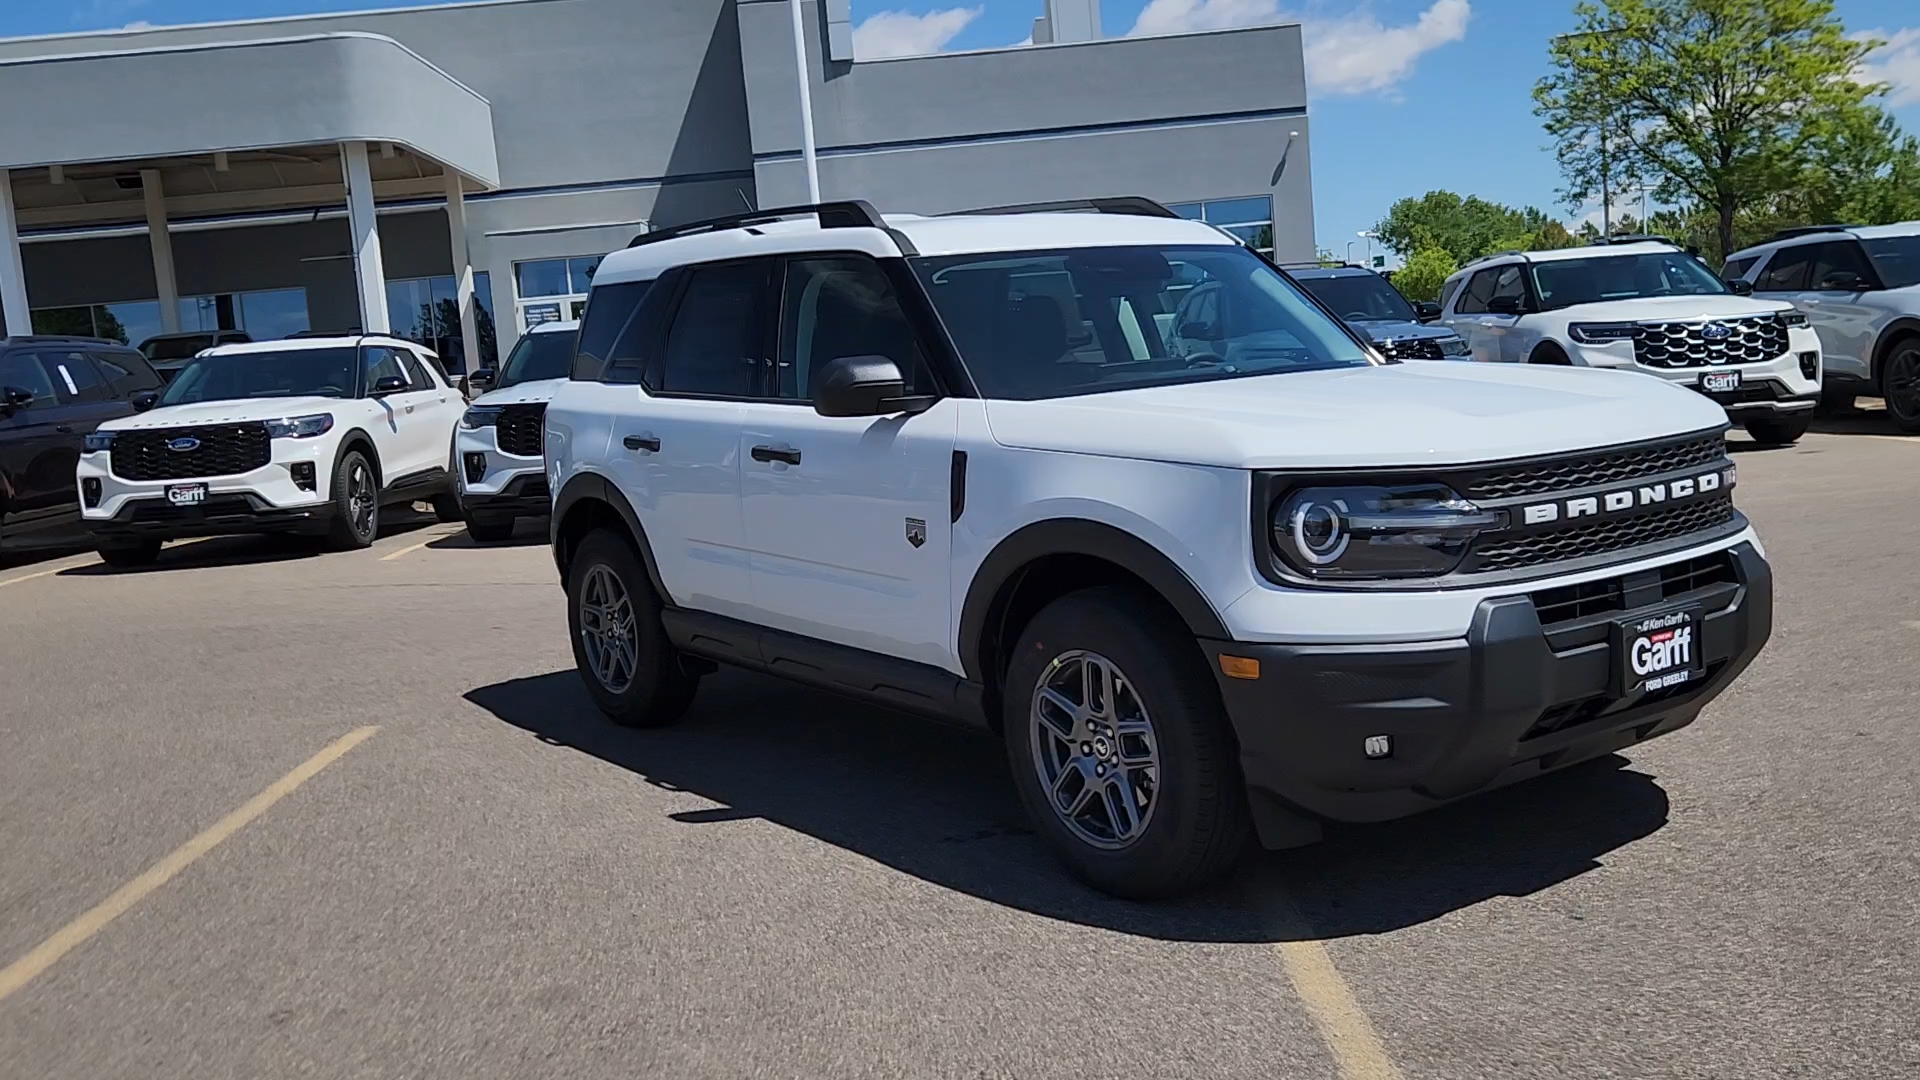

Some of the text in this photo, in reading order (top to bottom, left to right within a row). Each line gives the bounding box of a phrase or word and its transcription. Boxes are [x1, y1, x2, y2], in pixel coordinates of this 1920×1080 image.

[1703, 373, 1739, 389] Garff
[168, 487, 205, 502] Garff
[1524, 472, 1719, 525] BRONCO
[1649, 612, 1684, 630] Ken Garff
[1632, 626, 1691, 675] Garff
